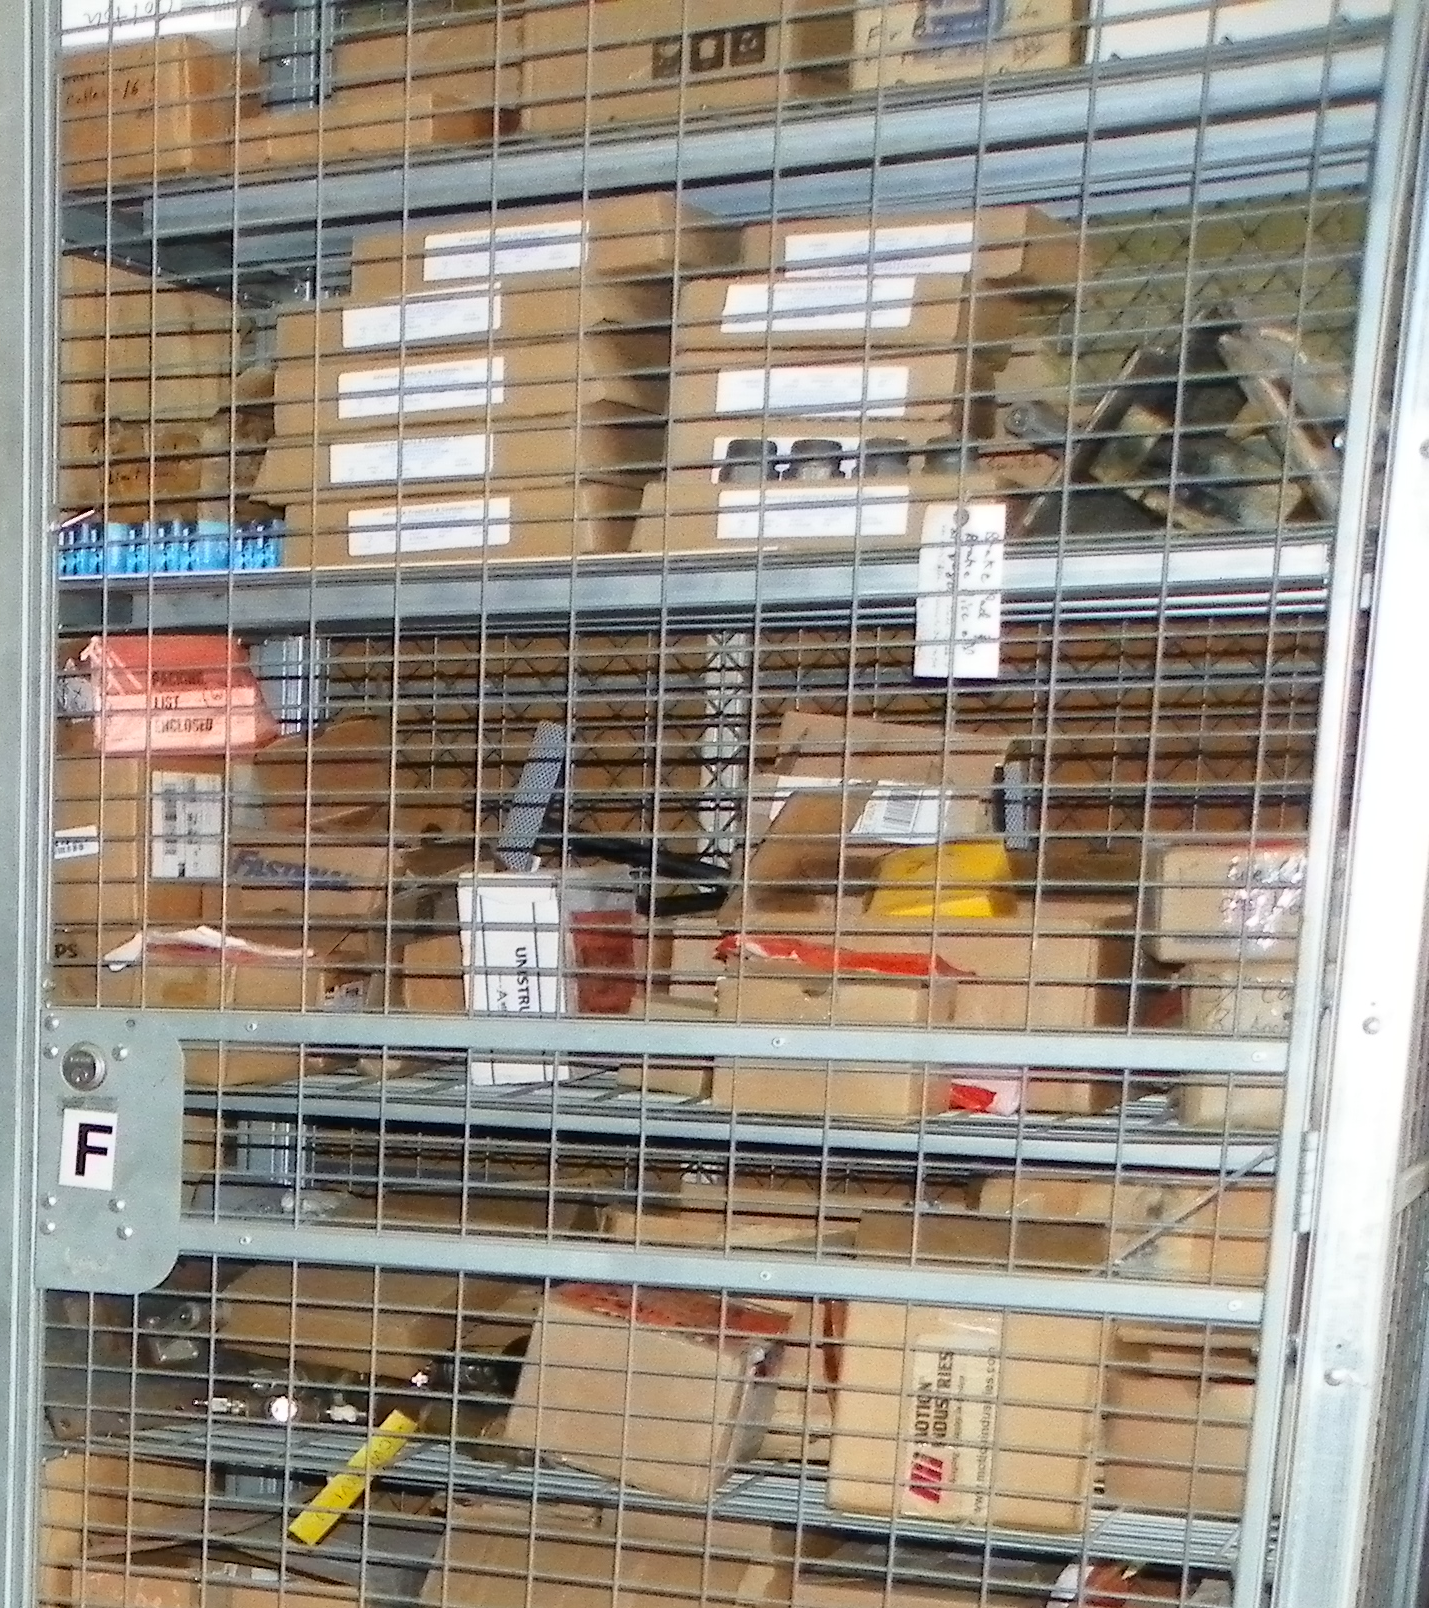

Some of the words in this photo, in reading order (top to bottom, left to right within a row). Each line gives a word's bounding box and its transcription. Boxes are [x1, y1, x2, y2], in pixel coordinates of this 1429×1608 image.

[153, 695, 181, 710] LIST
[75, 1122, 114, 1177] F
[931, 1351, 954, 1446] NDUSRIES
